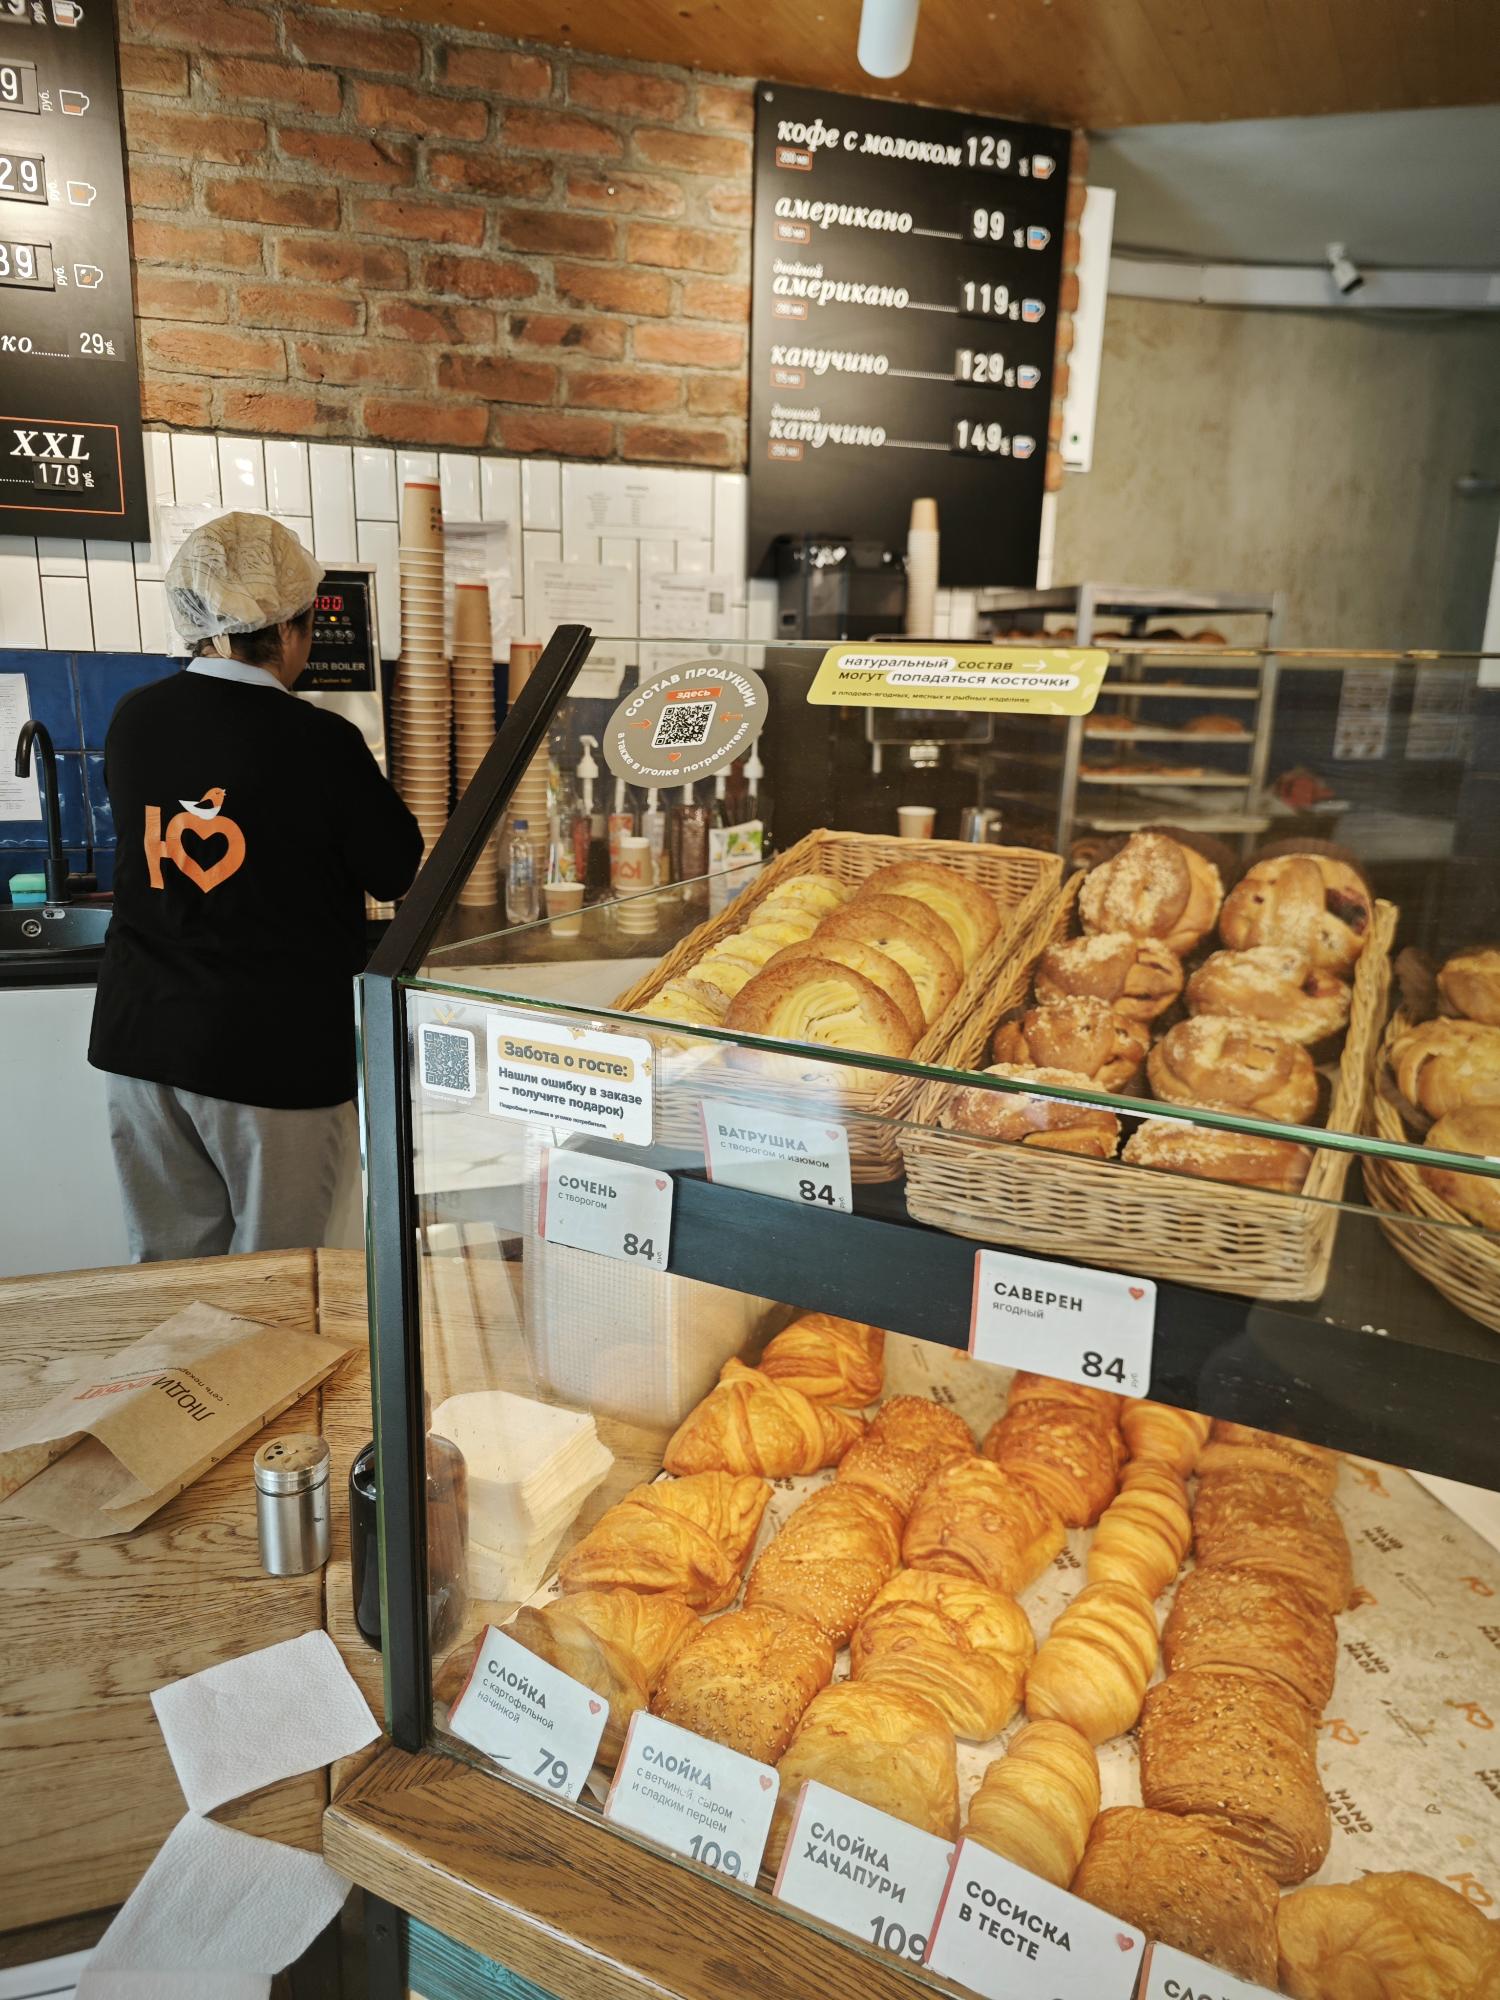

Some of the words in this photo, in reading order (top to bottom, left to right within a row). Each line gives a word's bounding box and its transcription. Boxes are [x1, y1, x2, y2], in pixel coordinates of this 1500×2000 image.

[40, 89, 53, 111] руб.
[777, 119, 840, 152] кофе
[843, 131, 858, 151] с
[860, 133, 962, 166] молоком
[966, 136, 1012, 169] 129
[775, 197, 913, 234] американо
[973, 208, 1005, 240] 99
[54, 265, 67, 285] руб.
[773, 277, 910, 308] американо
[964, 281, 1009, 314] 119
[79, 332, 104, 354] 29
[770, 345, 889, 375] капучино
[960, 350, 1004, 382] 129
[10, 430, 90, 460] XXL
[769, 420, 886, 448] капучино
[957, 420, 1002, 451] 149
[39, 462, 80, 485] 179
[305, 662, 328, 670] ATER
[331, 662, 365, 670] BOILER
[838, 670, 884, 683] могут
[892, 671, 986, 686] попадаться
[990, 674, 1071, 688] косточки
[845, 656, 949, 671] натуральный
[957, 660, 1013, 671] состав
[625, 674, 681, 717] СОСТАВ
[685, 667, 757, 708] ПРОДУКЦИИ
[676, 689, 712, 700] здесь
[617, 740, 634, 765] также
[632, 762, 641, 770] в
[638, 766, 680, 777] уголке
[683, 722, 750, 774] потребителя
[504, 1041, 560, 1065] Забота
[564, 1055, 574, 1067] о
[578, 1056, 628, 1078] госте:
[499, 1067, 539, 1084] Нашли
[540, 1075, 586, 1096] ошибку
[590, 1086, 597, 1095] в
[599, 1087, 643, 1105] заказе
[512, 1087, 566, 1106] получите
[569, 1098, 624, 1119] подарок)
[718, 1124, 808, 1153] ВАТРУШКА
[720, 1140, 726, 1149] с
[728, 1142, 776, 1159] творогом
[778, 1152, 785, 1160] и
[787, 1154, 829, 1169] изюмом
[558, 1174, 617, 1199] СОЧЕНЬ
[565, 1191, 607, 1209] творогом
[799, 1179, 836, 1206] 84
[623, 1233, 655, 1261] 84
[993, 1301, 1044, 1319] ягодный
[994, 1282, 1083, 1312] САВЕРЕН
[1082, 1351, 1125, 1384] 84
[152, 1377, 215, 1422] ЛЮДИ
[488, 1660, 547, 1709] СЛОЙКА
[477, 1691, 521, 1724] начинкой
[482, 1679, 489, 1687] с
[489, 1680, 555, 1730] картофельной
[533, 1747, 569, 1789] 79
[642, 1745, 712, 1790] СЛОЙКА
[632, 1781, 640, 1791] и
[641, 1786, 685, 1813] сладким
[686, 1808, 728, 1833] перцем
[636, 1767, 643, 1776] с
[697, 1796, 733, 1819] сыром
[1335, 1788, 1373, 1833] HAND
[690, 1834, 741, 1879] 109
[811, 1821, 890, 1872] СЛОЙКА
[803, 1841, 906, 1904] ХАЧАПУРИ
[959, 1902, 973, 1921] В
[977, 1914, 1040, 1961] ТЕСТЕ
[966, 1879, 1072, 1952] СОСИСКА
[870, 1915, 928, 1967] 109
